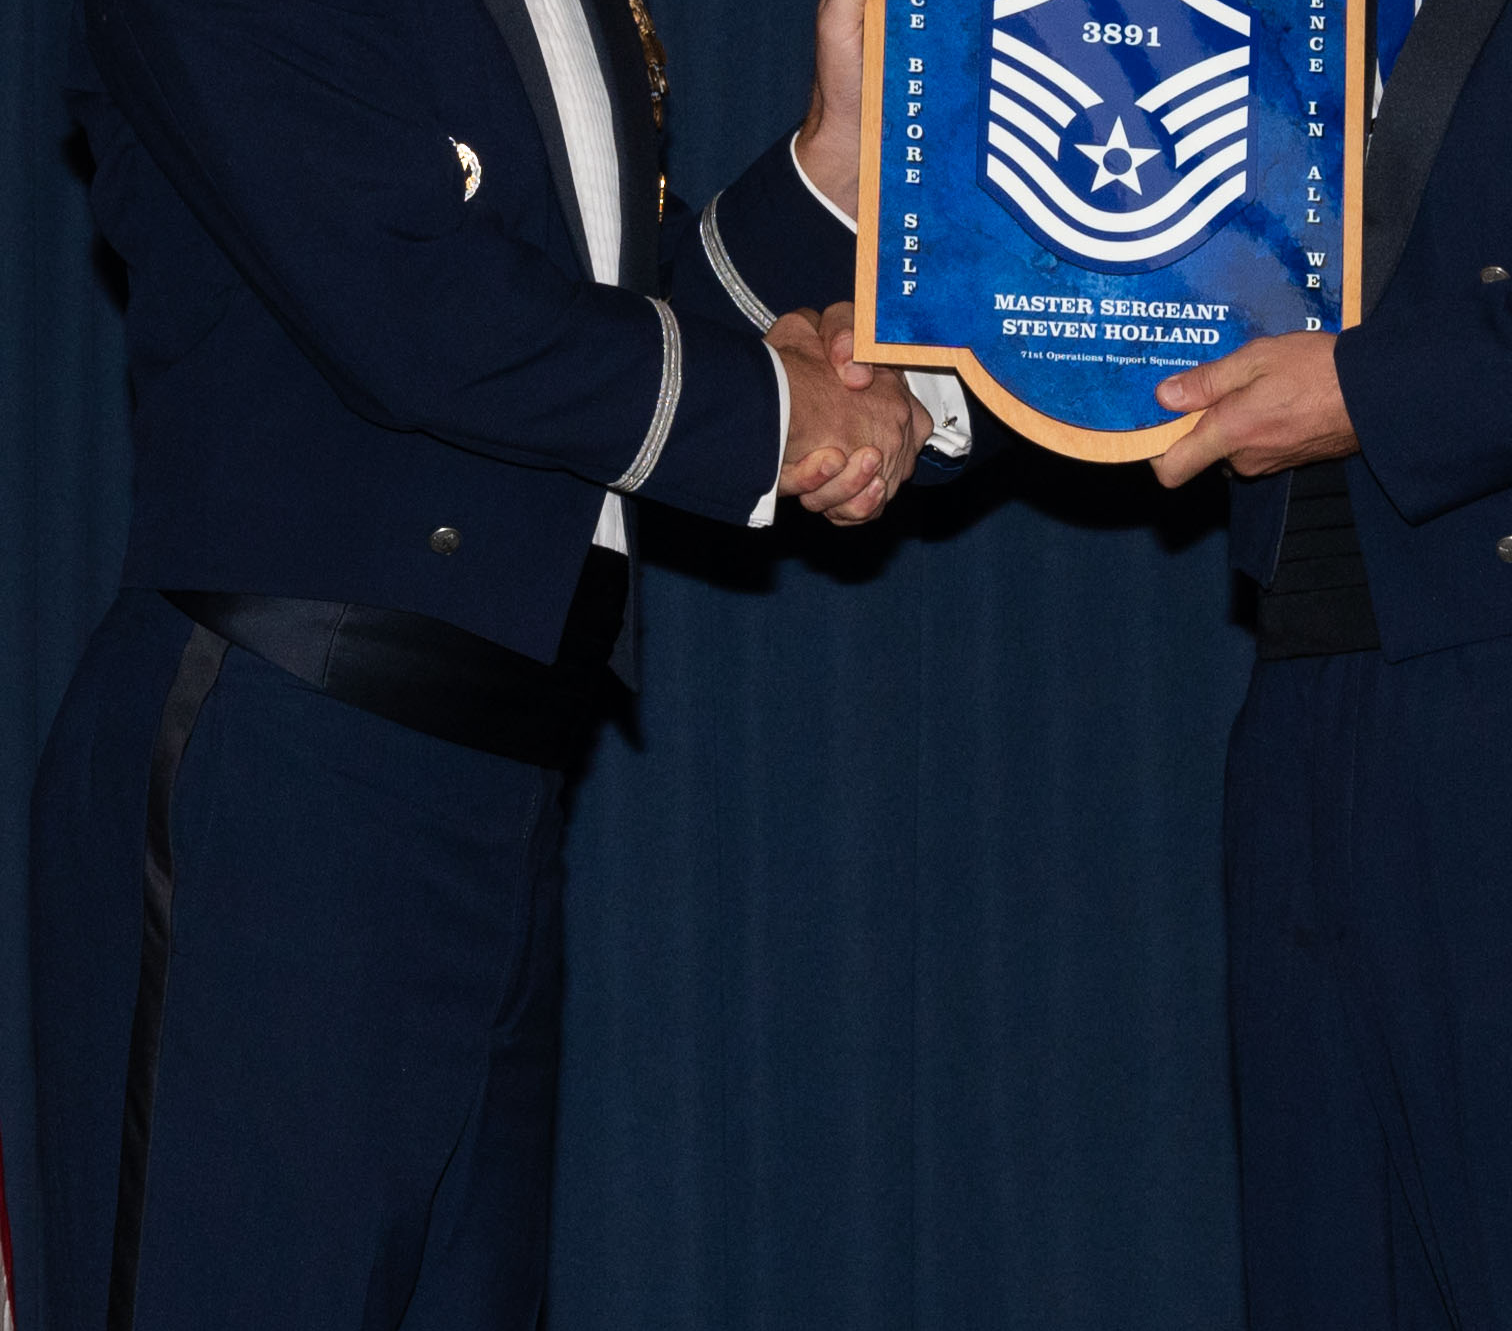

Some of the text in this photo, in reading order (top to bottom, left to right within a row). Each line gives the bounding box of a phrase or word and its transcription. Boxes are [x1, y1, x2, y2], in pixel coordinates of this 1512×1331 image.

[1082, 21, 1162, 47] 3891
[904, 57, 924, 184] BEFORE
[1308, 101, 1324, 137] IN
[1307, 166, 1322, 223] ALL
[901, 213, 919, 295] SELF
[1306, 252, 1325, 288] WE
[994, 294, 1230, 321] MASTER SERGEANT
[1002, 319, 1220, 345] STEVEN HOLLAND
[1305, 317, 1322, 332] D
[1020, 350, 1199, 367] 71st Operations Support Squadron
